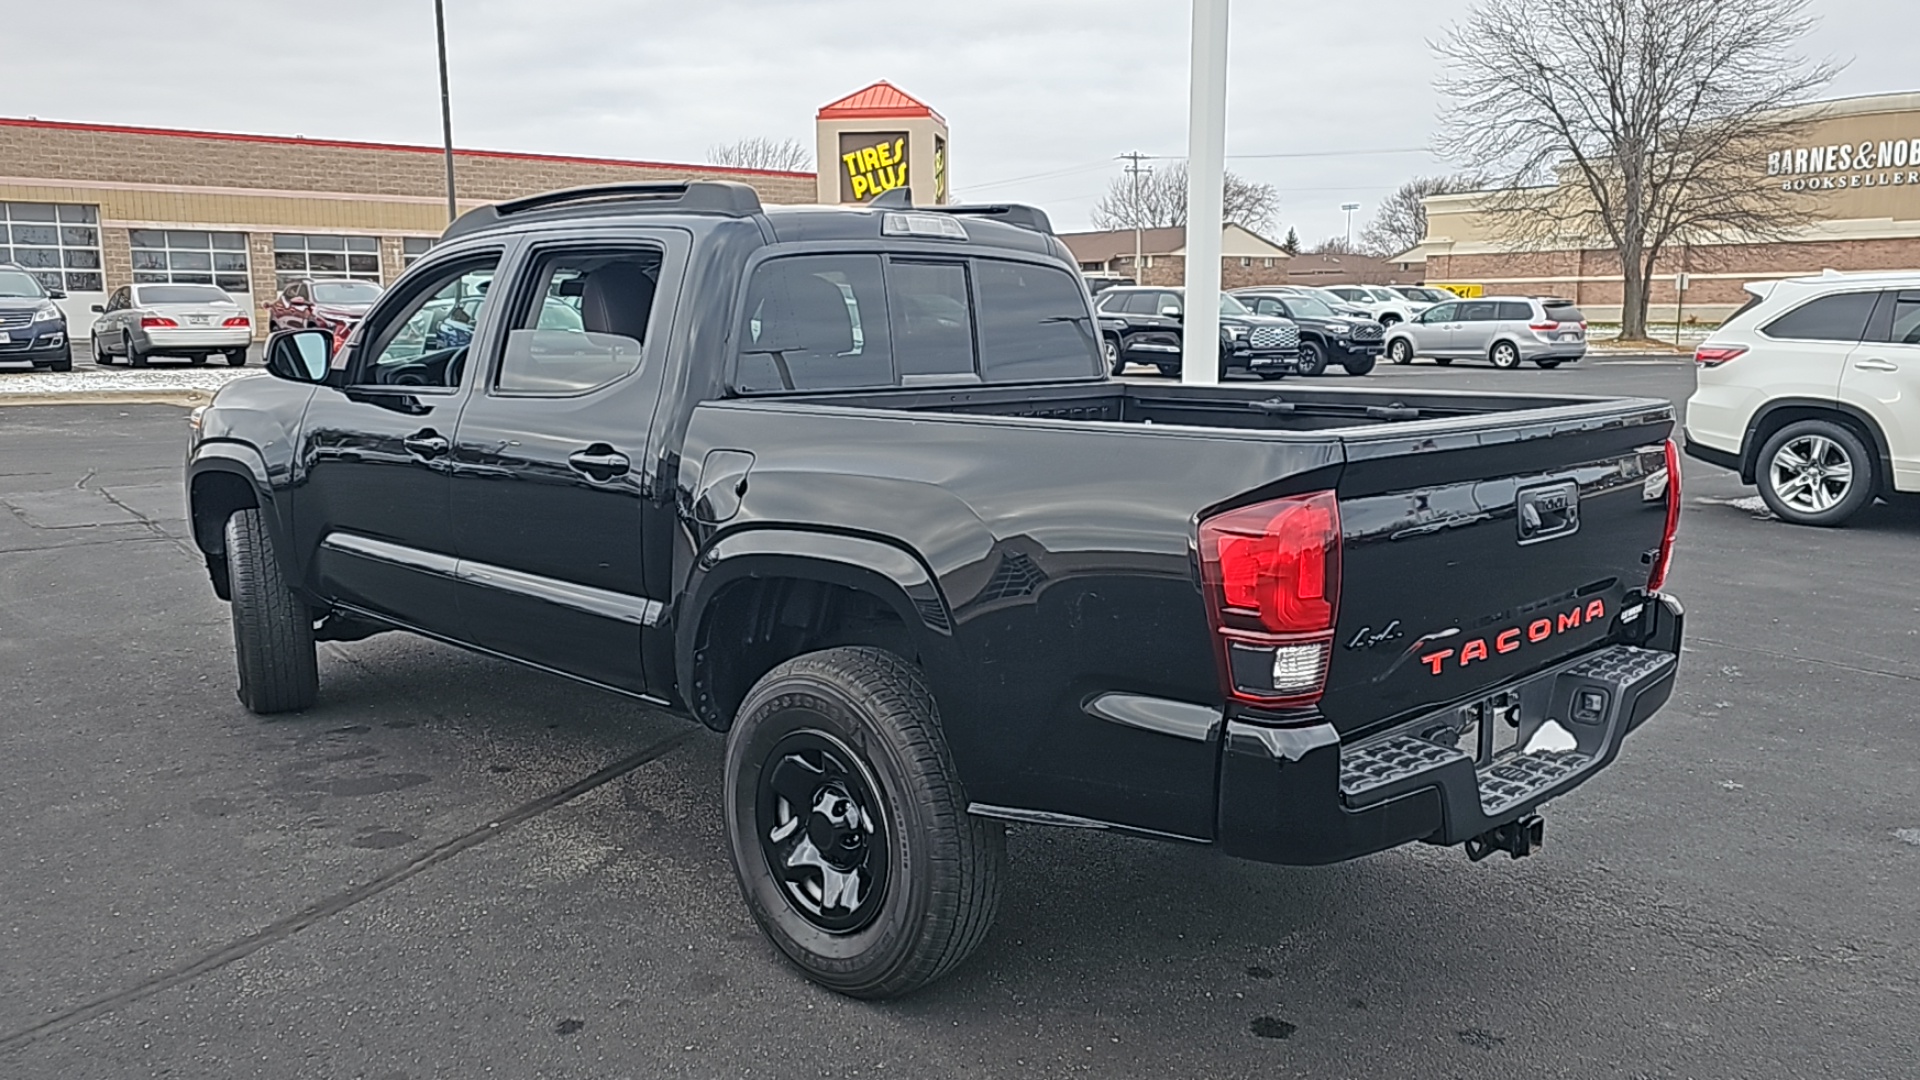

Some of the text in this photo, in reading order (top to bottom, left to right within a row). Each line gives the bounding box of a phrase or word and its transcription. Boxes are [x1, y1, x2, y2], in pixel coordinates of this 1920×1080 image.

[842, 137, 904, 176] TIRES
[1767, 144, 1852, 176] BARNES
[851, 162, 907, 199] PLUS
[1421, 599, 1604, 675] TACOMA
